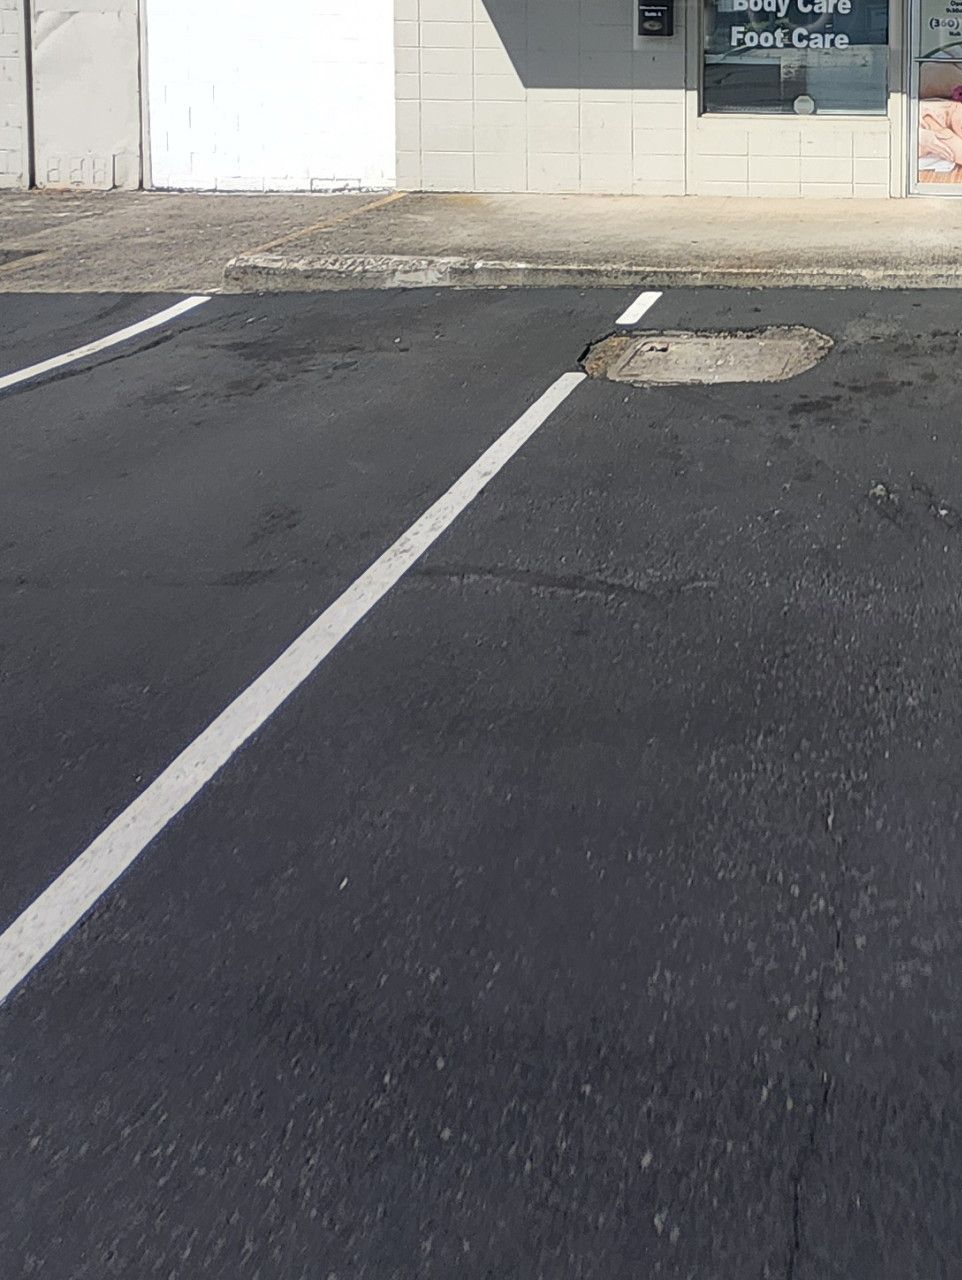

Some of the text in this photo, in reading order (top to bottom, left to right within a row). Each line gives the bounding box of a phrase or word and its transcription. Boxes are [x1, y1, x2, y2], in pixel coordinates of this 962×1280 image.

[929, 17, 959, 30] (360)
[731, 26, 850, 49] Foot Care
